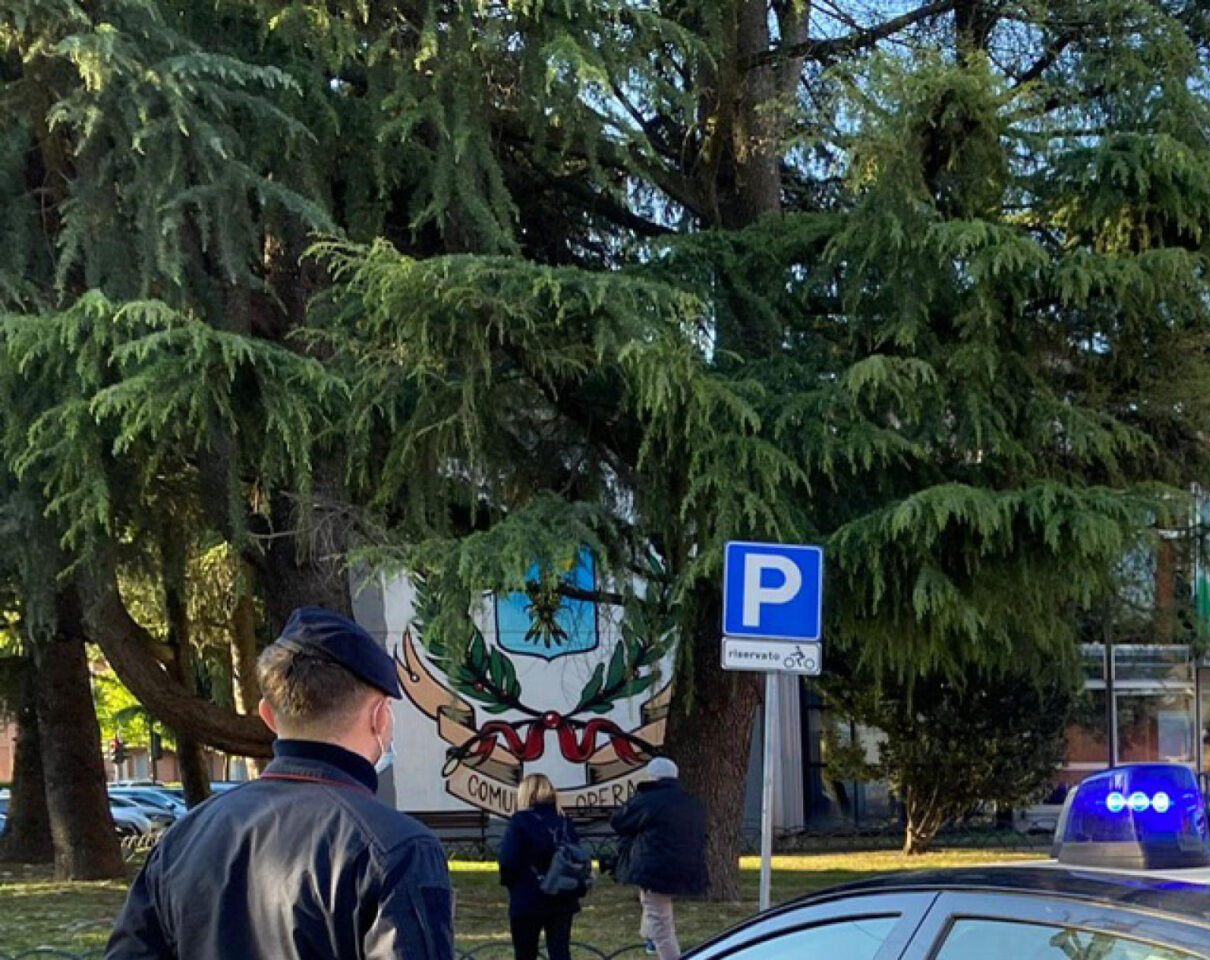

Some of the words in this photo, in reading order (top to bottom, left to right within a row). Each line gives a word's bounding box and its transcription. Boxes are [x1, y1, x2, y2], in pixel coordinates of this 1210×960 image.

[743, 553, 802, 627] P
[728, 648, 780, 661] riservato
[467, 774, 517, 813] COMU
